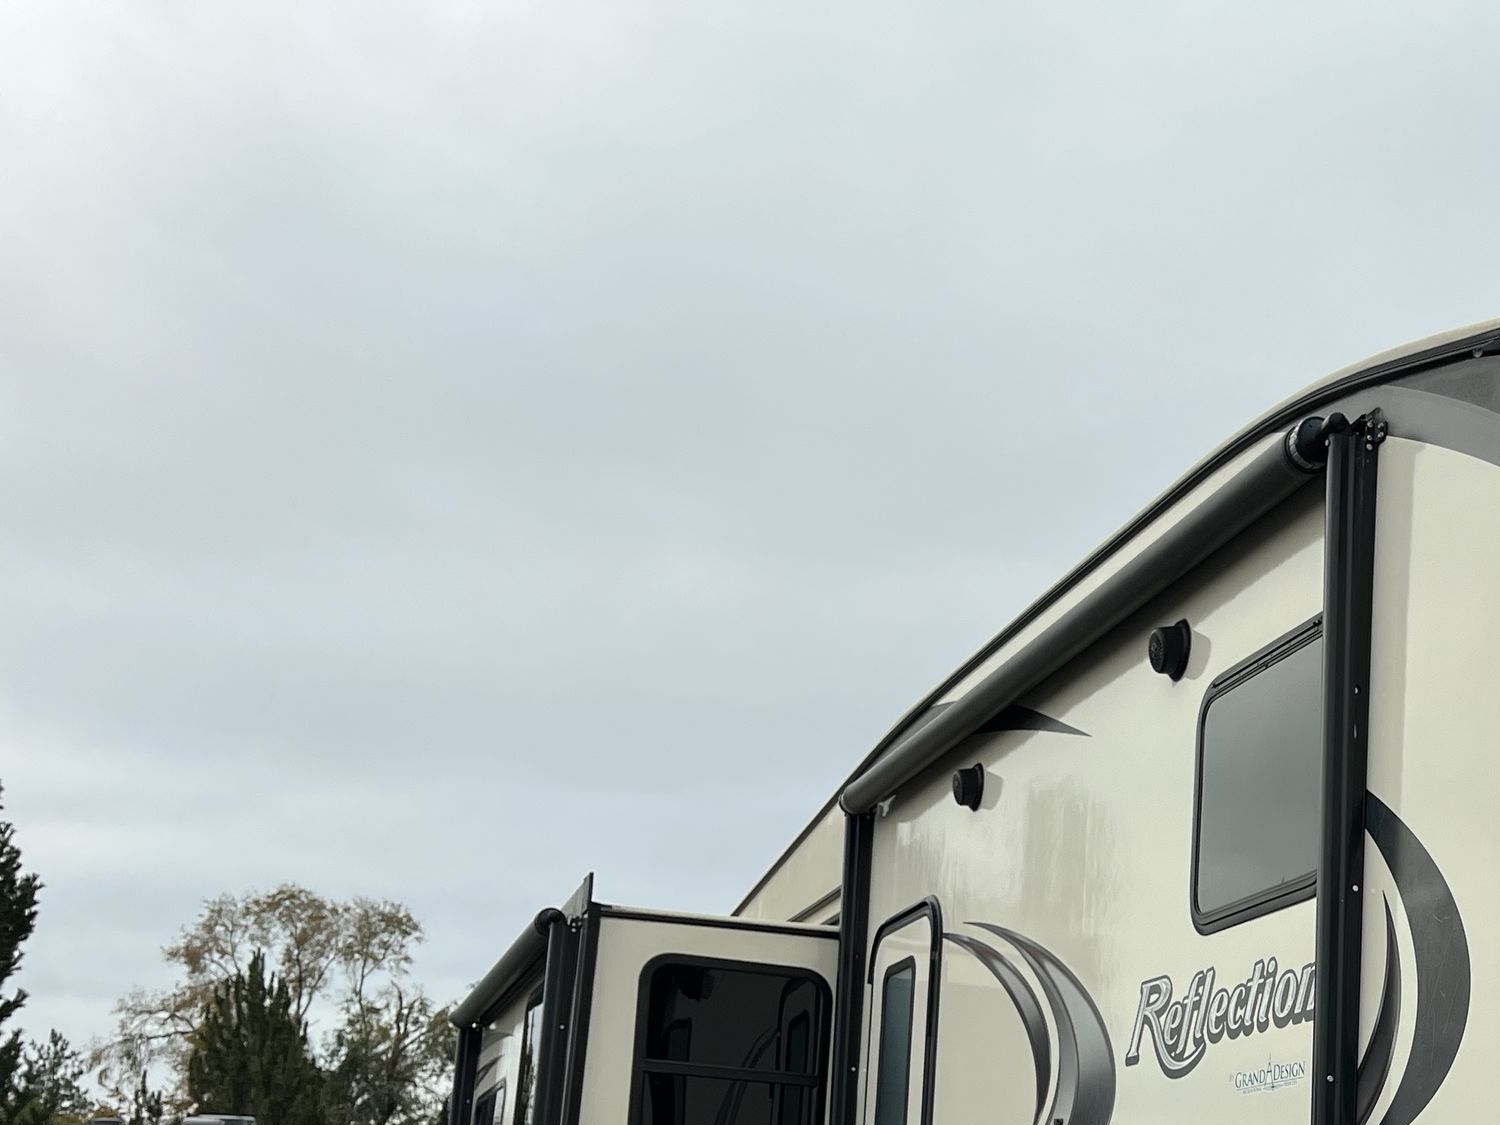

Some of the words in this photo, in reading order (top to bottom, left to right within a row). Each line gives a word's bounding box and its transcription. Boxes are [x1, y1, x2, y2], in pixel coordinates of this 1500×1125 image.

[1126, 957, 1315, 1079] Reflection
[1234, 1069, 1266, 1089] GRAND
[1273, 1061, 1306, 1081] DESIGN
